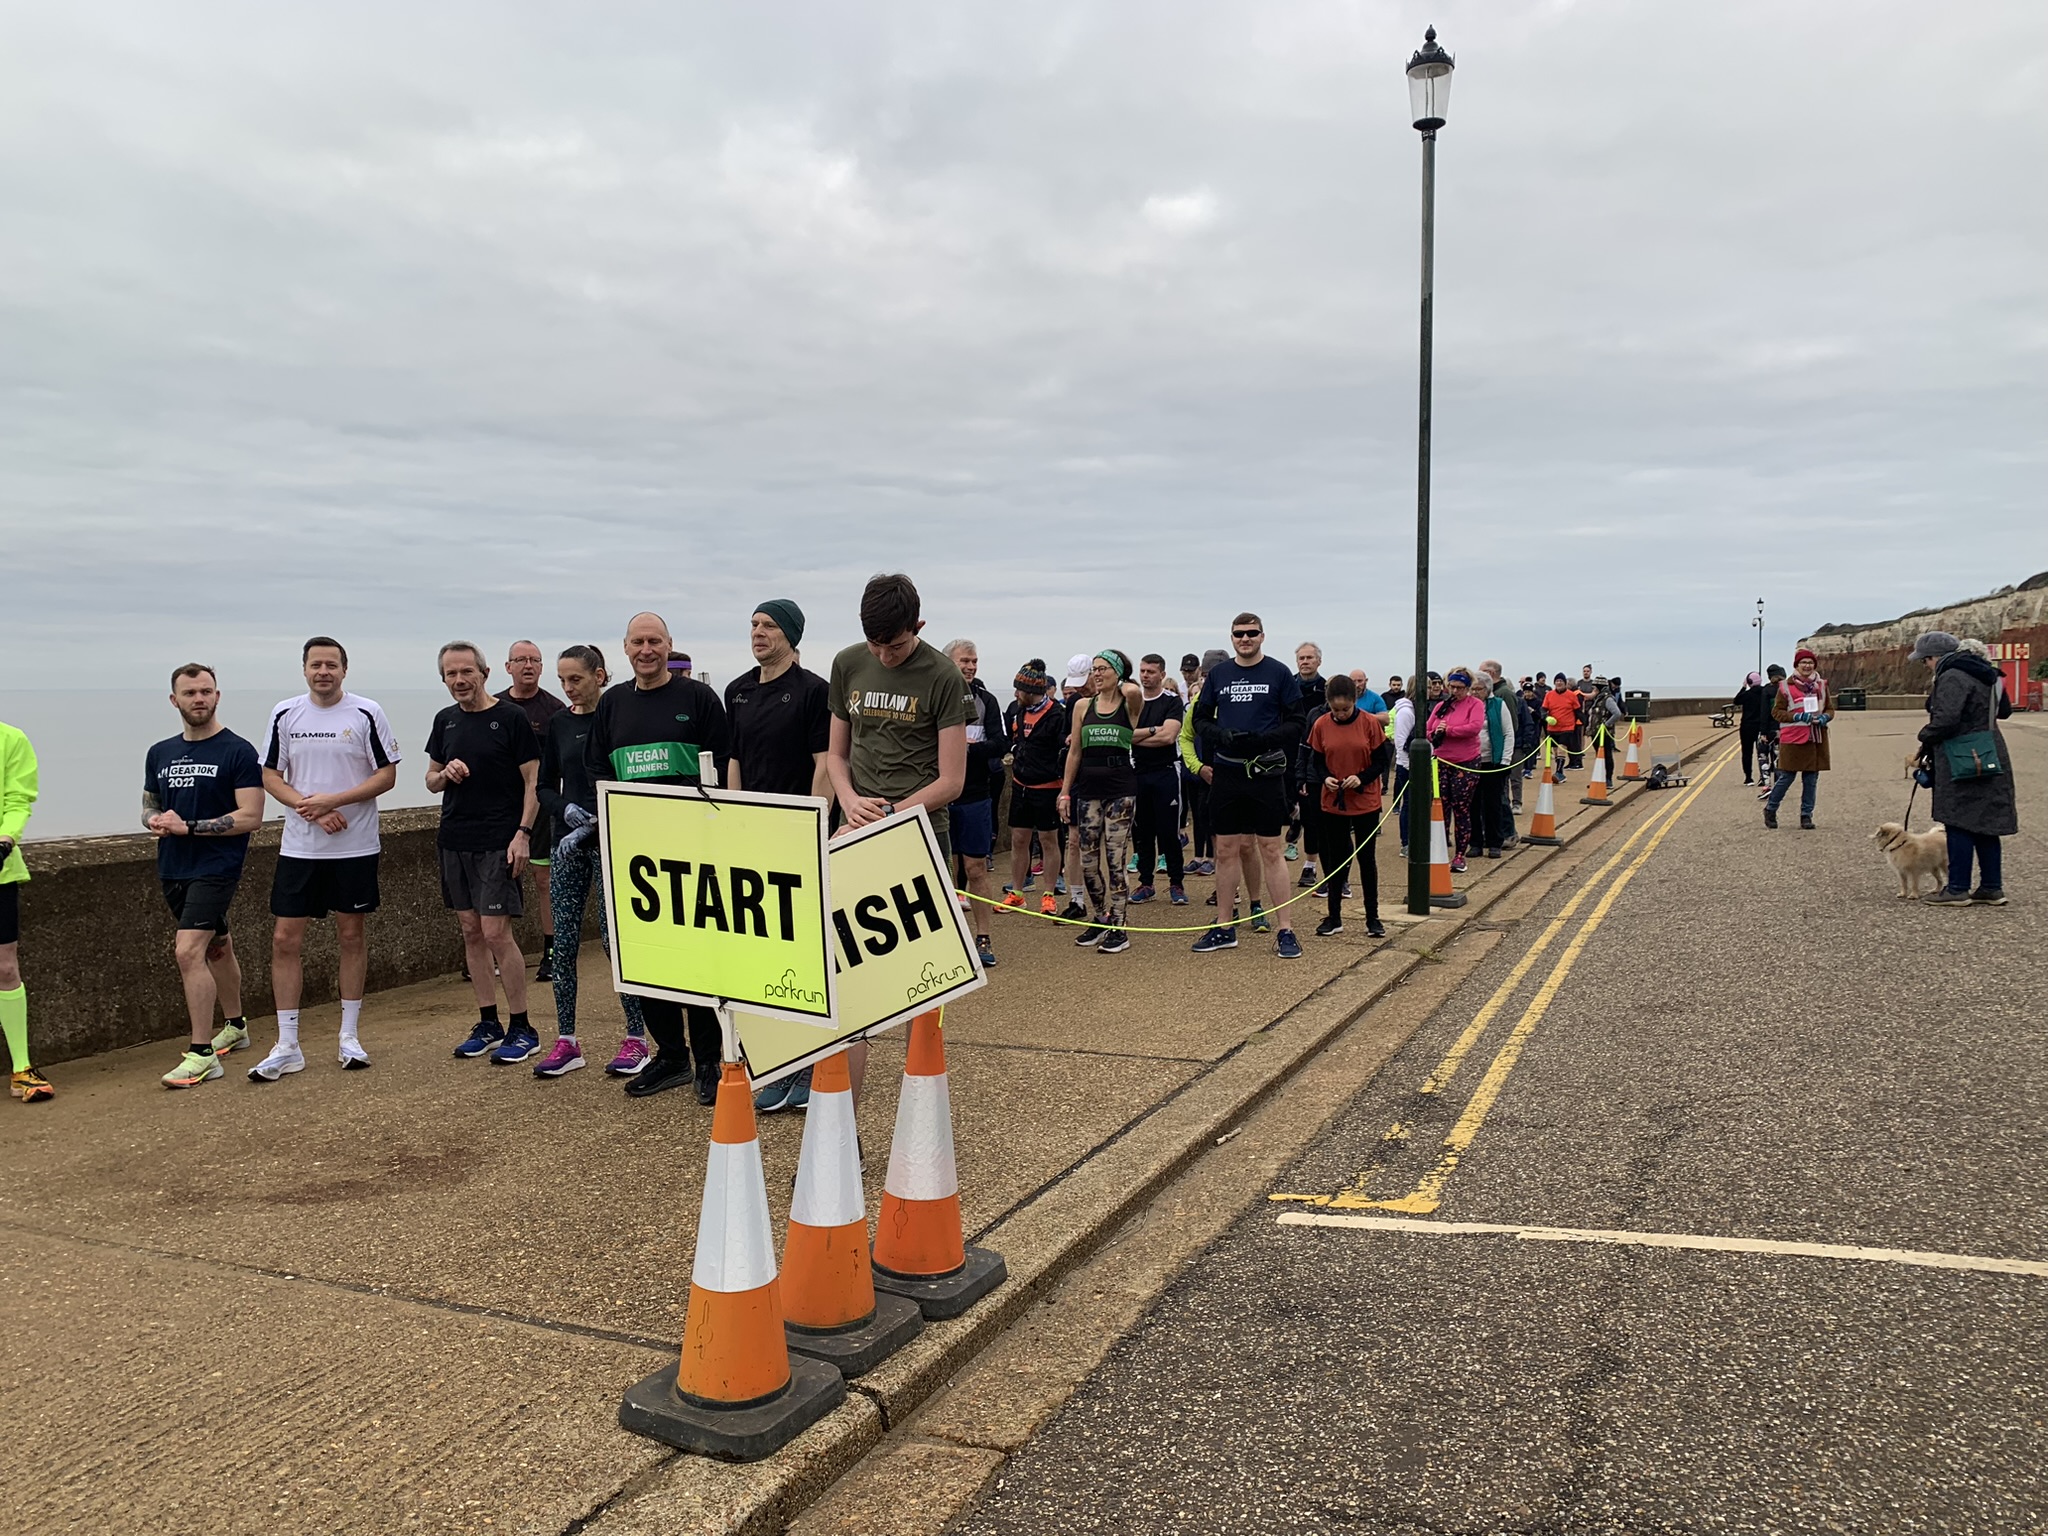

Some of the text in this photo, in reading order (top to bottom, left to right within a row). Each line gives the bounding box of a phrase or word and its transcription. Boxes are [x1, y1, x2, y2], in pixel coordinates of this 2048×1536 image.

[864, 692, 918, 713] OUTLAW X
[1230, 694, 1252, 702] 2022
[892, 711, 899, 719] 10
[900, 713, 916, 722] YEARS
[1089, 728, 1119, 736] VEGAN
[626, 748, 669, 763] VEGAN
[171, 766, 215, 775] GEAR 10K
[626, 762, 669, 774] RUNNERS
[168, 777, 195, 788] 2022
[629, 855, 802, 941] START
[832, 874, 943, 974] ISH
[765, 968, 825, 1004] parkrun
[907, 962, 966, 1002] parkrun
